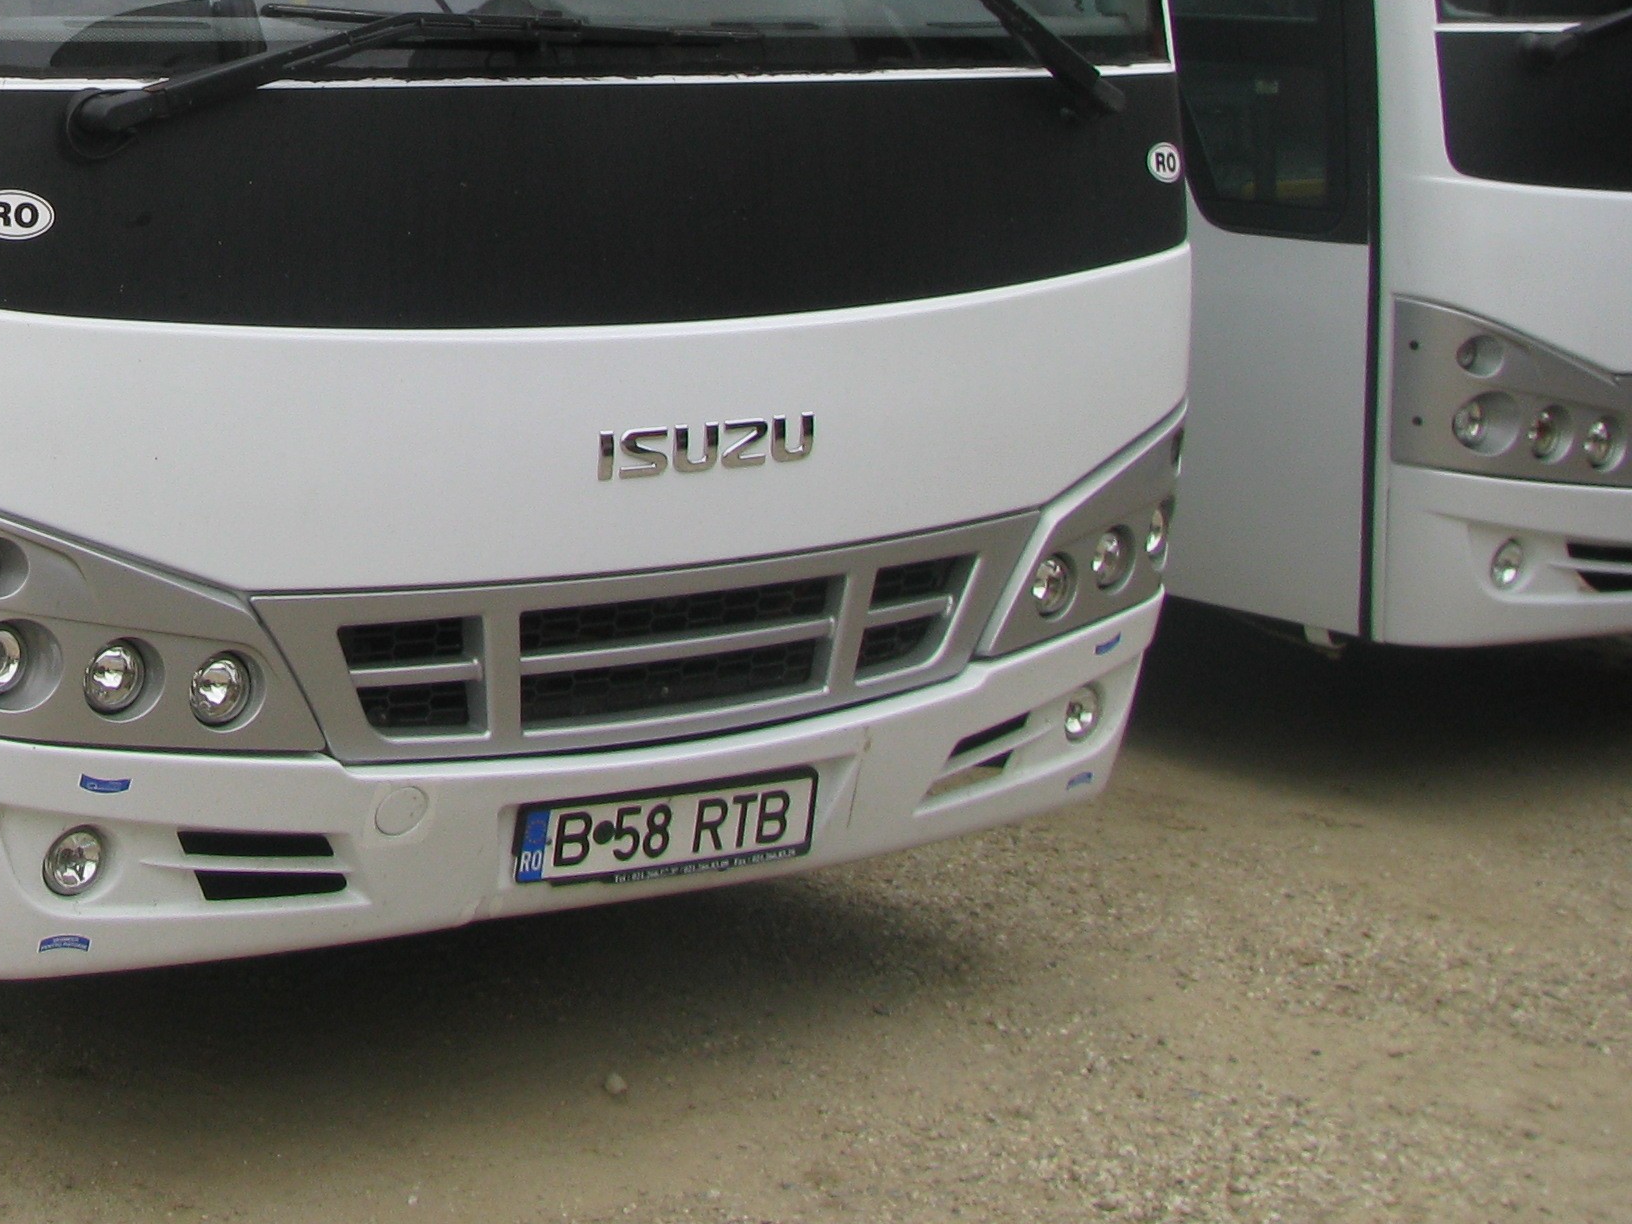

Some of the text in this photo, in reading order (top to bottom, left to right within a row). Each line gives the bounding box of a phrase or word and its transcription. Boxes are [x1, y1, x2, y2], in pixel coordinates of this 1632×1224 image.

[1155, 152, 1176, 172] RO
[597, 411, 815, 480] ISUZU
[692, 790, 790, 853] RTB
[519, 850, 542, 873] RO
